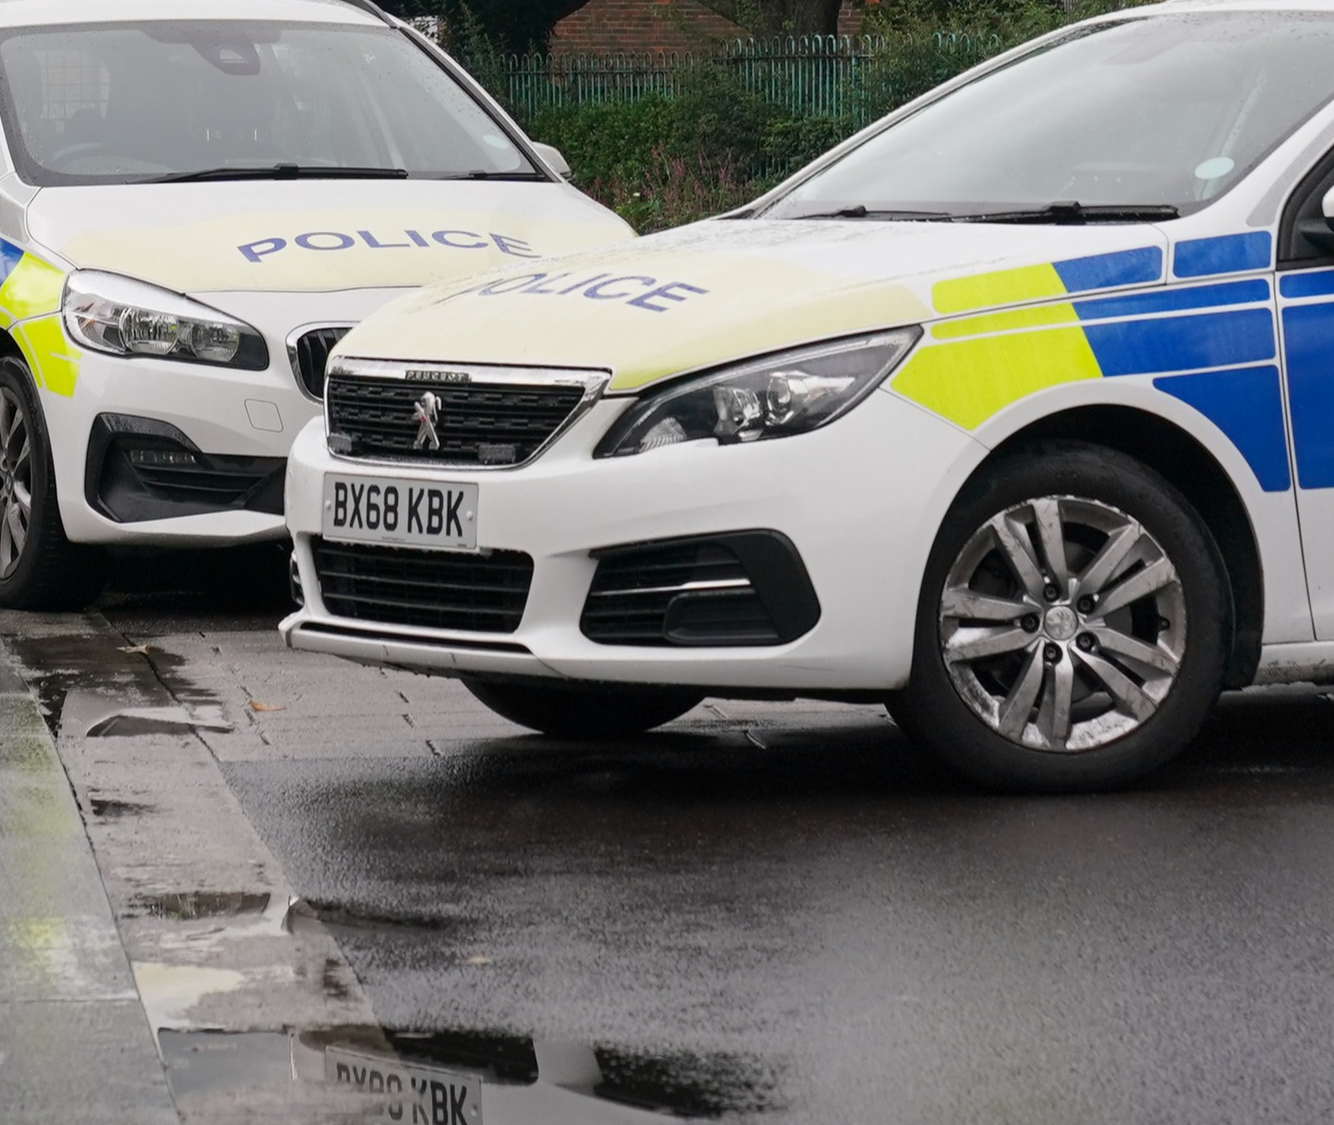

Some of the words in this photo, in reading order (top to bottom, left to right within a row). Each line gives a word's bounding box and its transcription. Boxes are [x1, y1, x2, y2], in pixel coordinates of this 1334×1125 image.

[237, 229, 542, 263] POLICE
[333, 482, 399, 531] BX68
[407, 487, 464, 537] KBK
